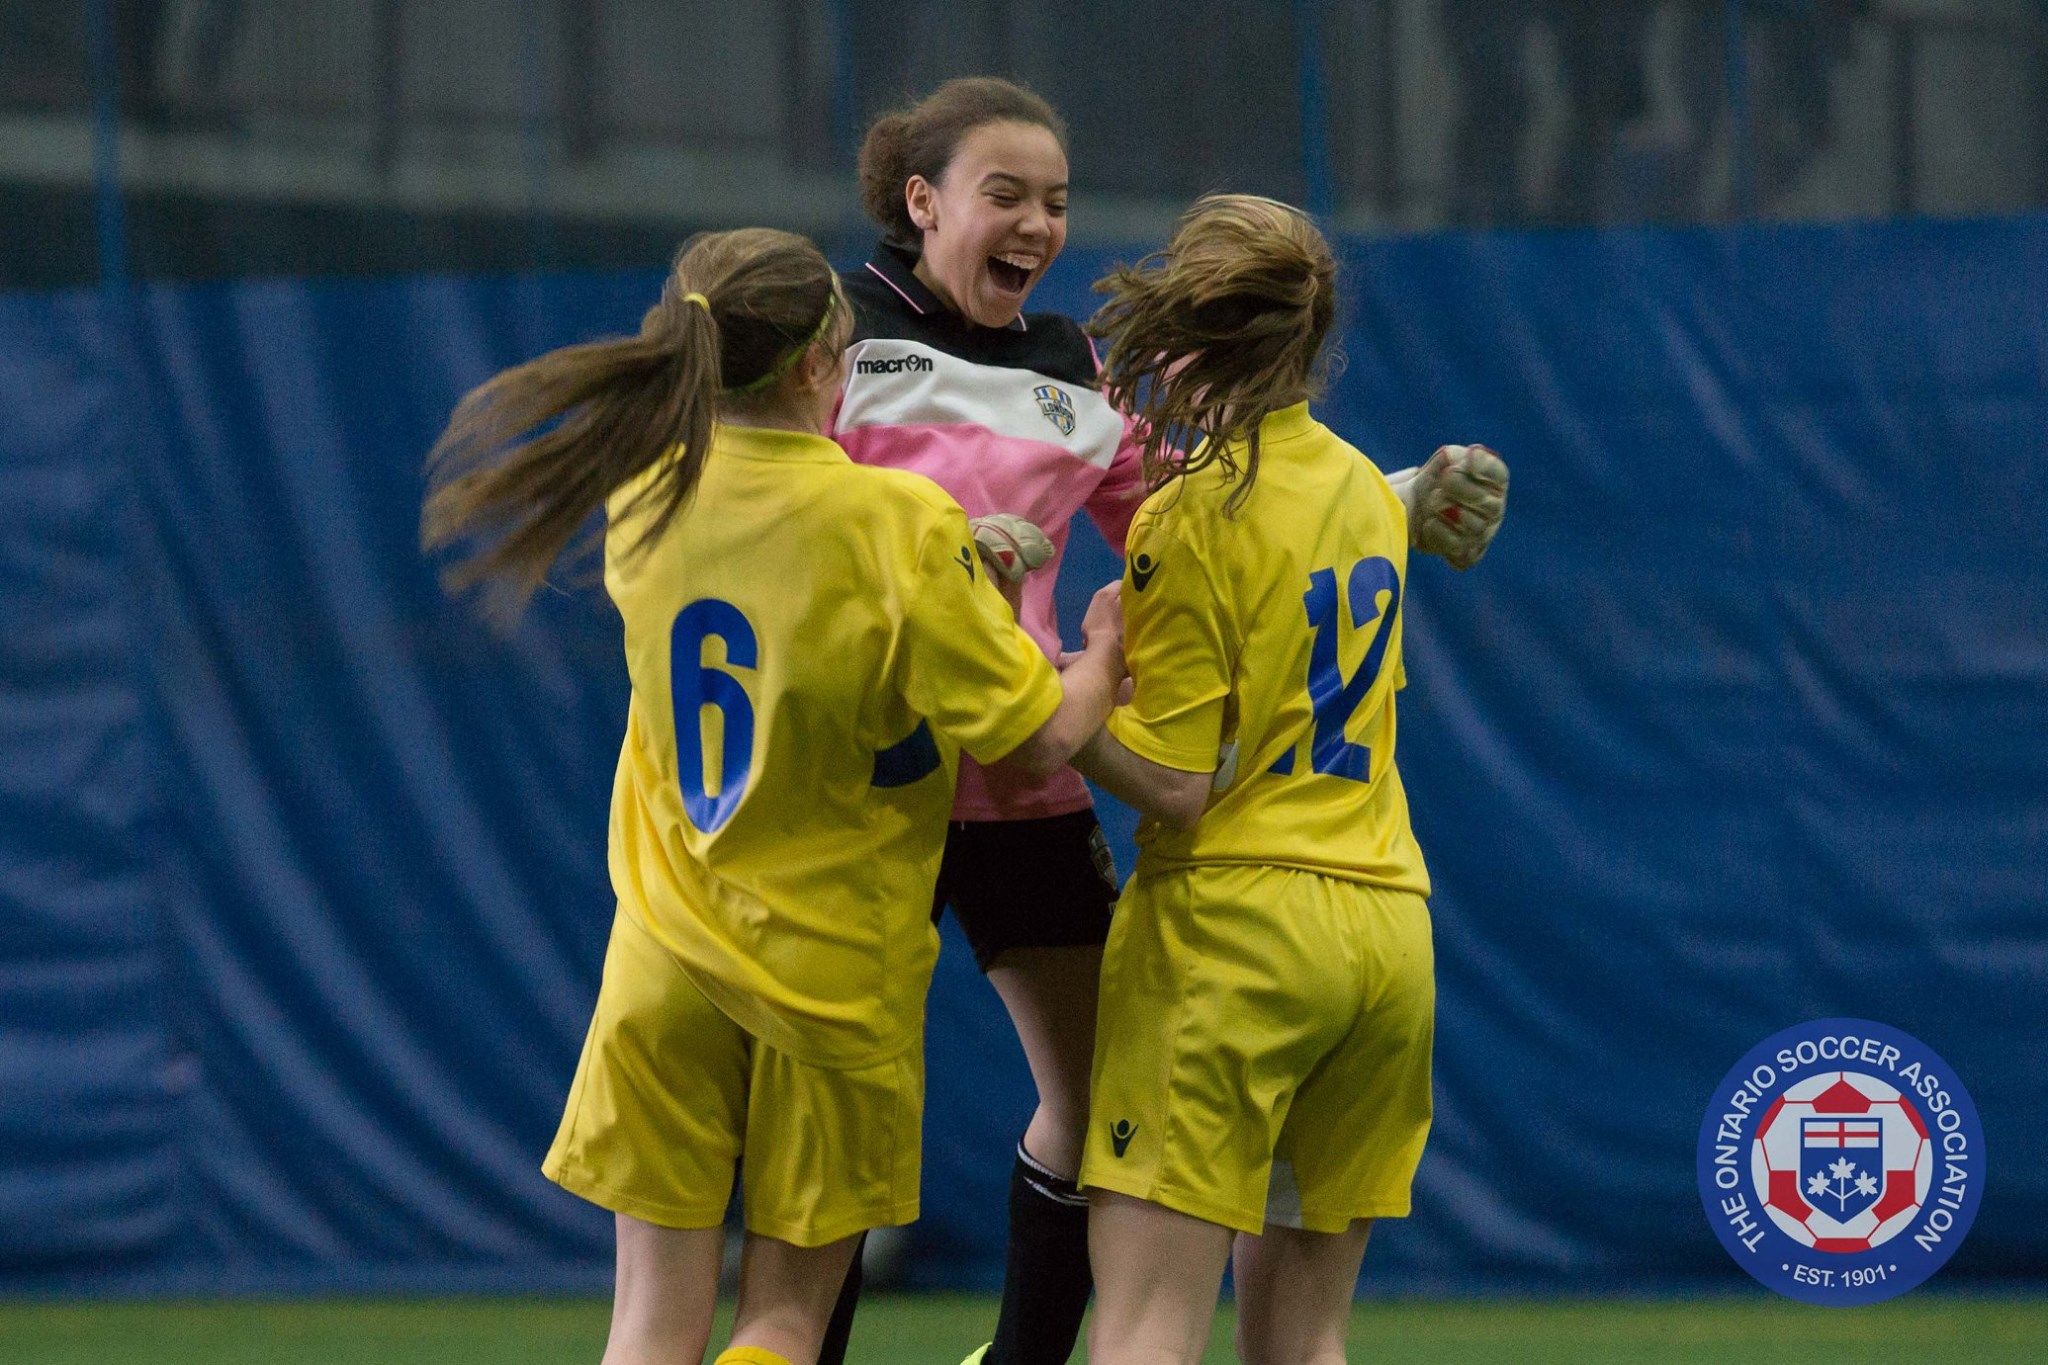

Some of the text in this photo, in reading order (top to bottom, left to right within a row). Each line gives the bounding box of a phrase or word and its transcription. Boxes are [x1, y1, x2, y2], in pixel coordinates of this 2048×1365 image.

[857, 354, 933, 374] macron
[670, 597, 758, 834] 6
[1267, 556, 1399, 784] 12
